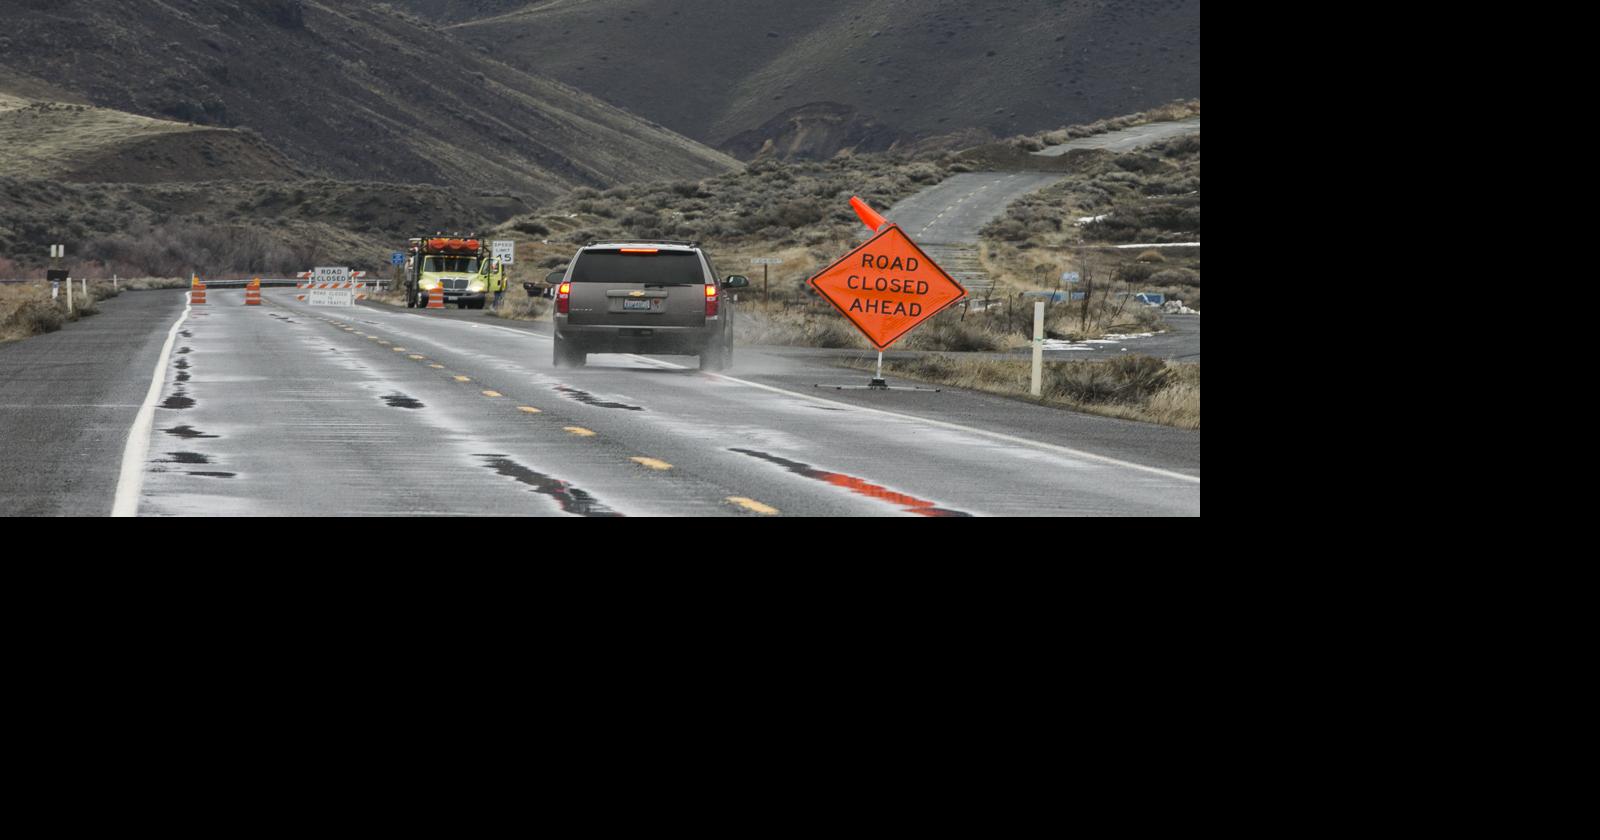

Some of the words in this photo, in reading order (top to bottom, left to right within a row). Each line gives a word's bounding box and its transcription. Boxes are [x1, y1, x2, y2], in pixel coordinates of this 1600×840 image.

[861, 253, 919, 272] ROAD
[847, 275, 929, 295] CLOSED
[849, 298, 922, 317] AHEAD
